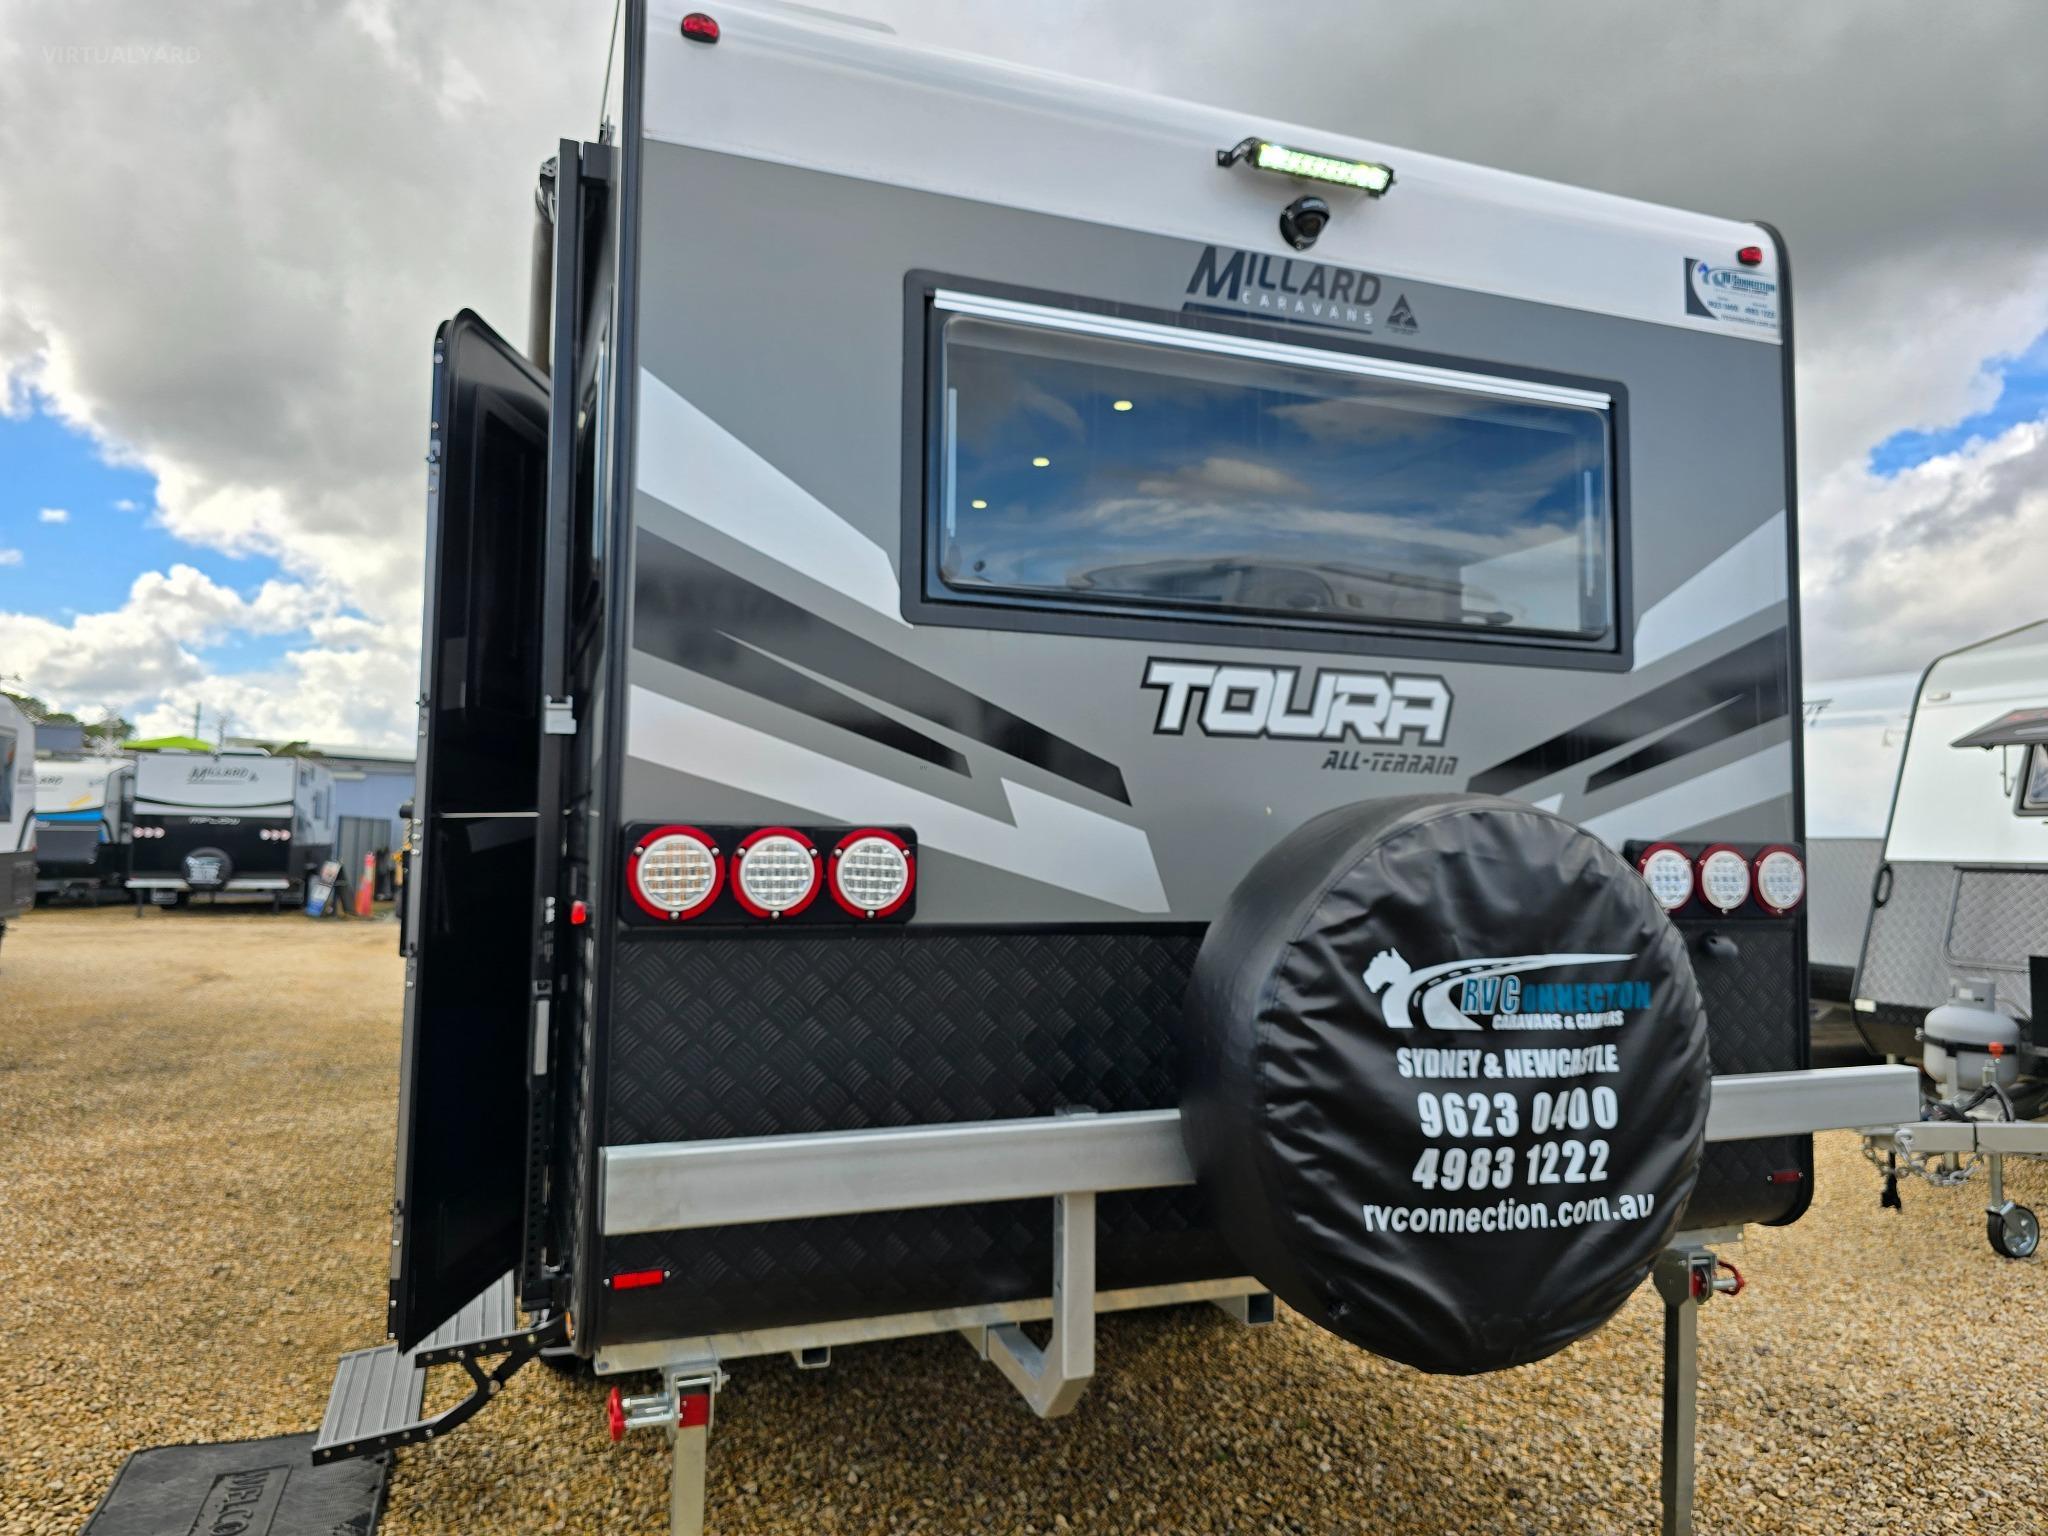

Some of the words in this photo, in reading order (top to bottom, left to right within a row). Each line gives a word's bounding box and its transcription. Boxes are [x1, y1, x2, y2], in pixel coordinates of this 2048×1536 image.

[1186, 246, 1382, 307] MILLARD
[1241, 291, 1373, 325] CARAVANS
[1140, 656, 1455, 747] TOURA
[1321, 750, 1458, 776] ALL-TERRAIN
[1396, 1047, 1482, 1078] SYDNEY
[1483, 1052, 1503, 1079] &
[1504, 1044, 1620, 1078] NEWCASTLE
[1417, 1091, 1519, 1138] 9623
[1531, 1086, 1618, 1135] 0400
[1412, 1146, 1515, 1192] 4983
[1526, 1139, 1610, 1186] 1222
[1362, 1193, 1655, 1233] rvconnection.com.au
